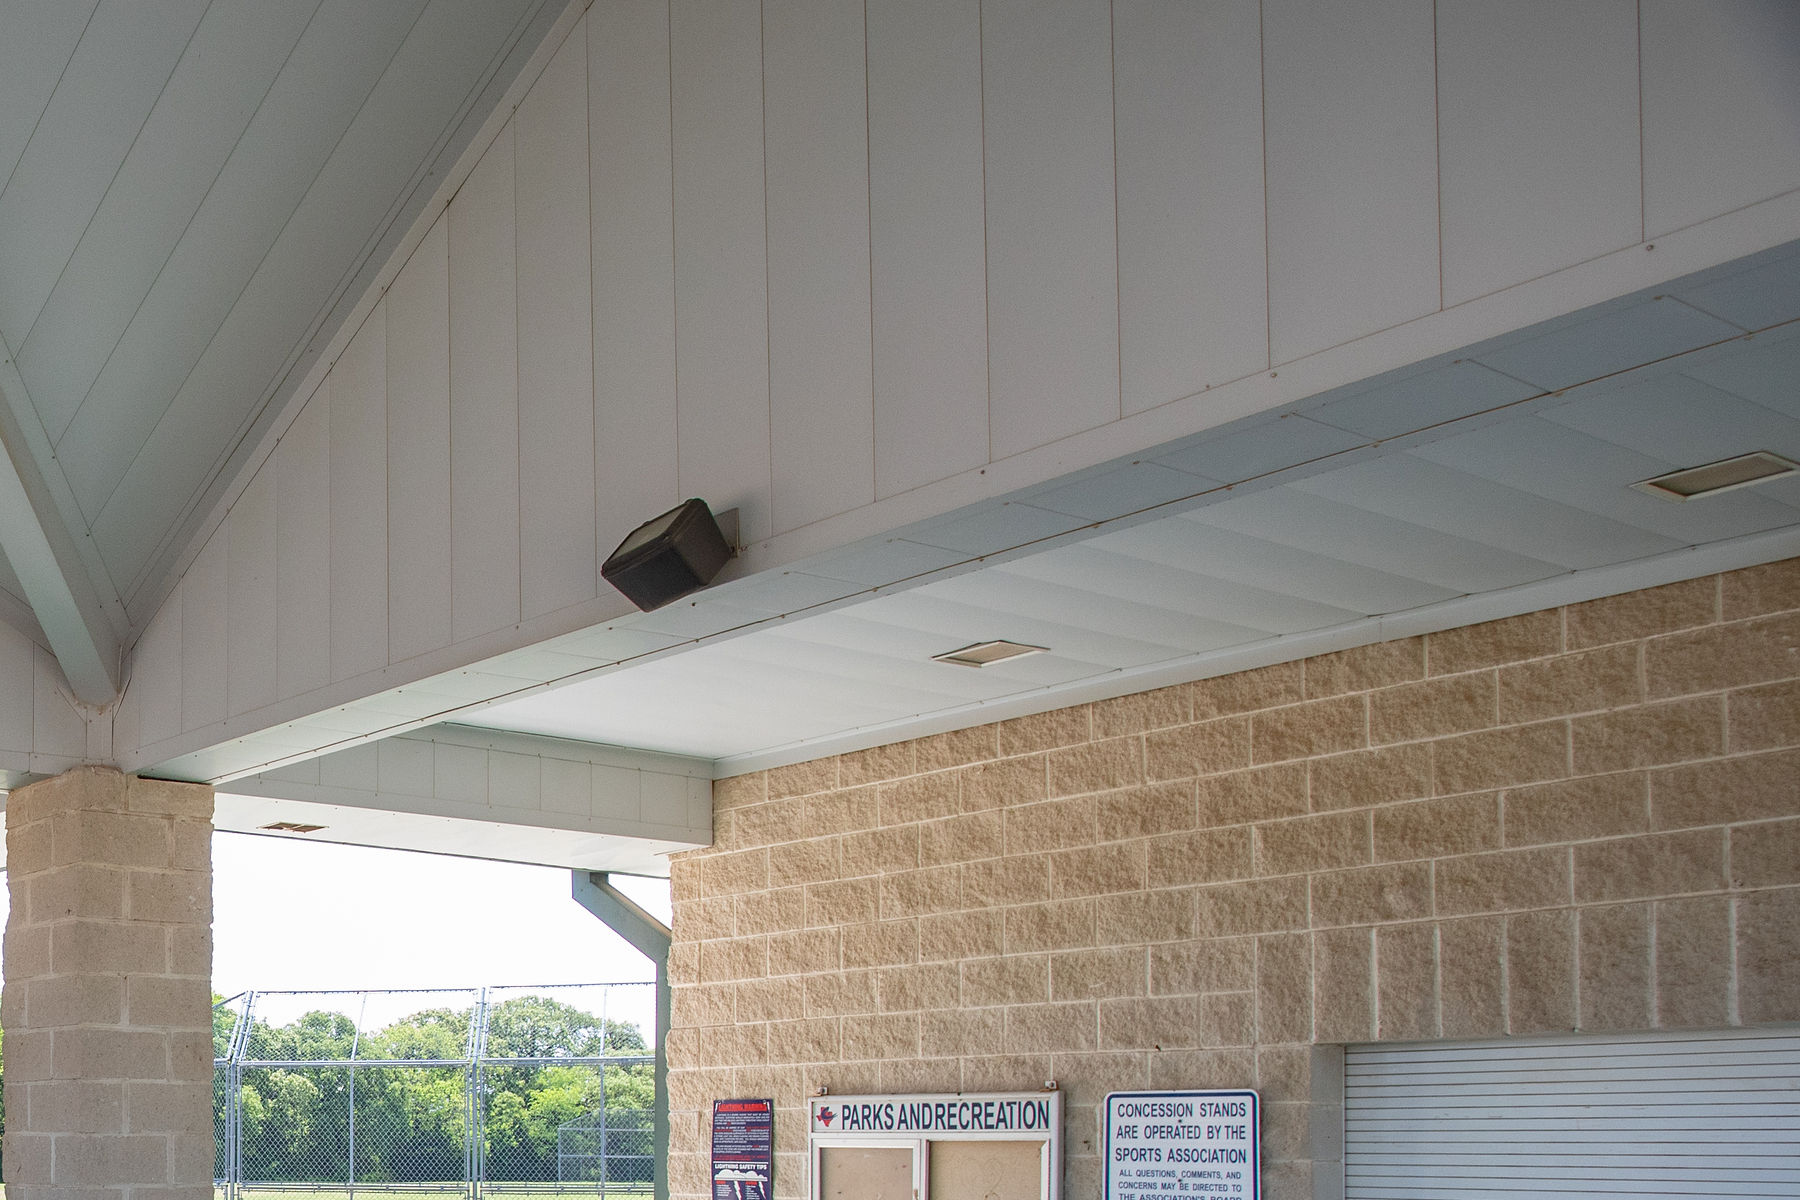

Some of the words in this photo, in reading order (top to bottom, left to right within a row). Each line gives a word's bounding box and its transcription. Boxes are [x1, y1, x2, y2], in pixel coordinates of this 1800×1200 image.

[841, 1103, 894, 1130] PARKS
[1117, 1103, 1193, 1118] CONCESSION
[1199, 1102, 1247, 1117] STANDS
[1116, 1125, 1138, 1139] ARE
[1144, 1125, 1201, 1139] OPERATED
[1207, 1125, 1222, 1139] BY
[1224, 1125, 1246, 1140] THE
[1115, 1147, 1162, 1162] SPORTS
[1167, 1148, 1247, 1164] ASSOCIATION
[1119, 1169, 1132, 1177] ALL
[1136, 1169, 1178, 1179] QUESTIONS,
[1181, 1170, 1223, 1180] COMMENTS,
[1226, 1171, 1241, 1179] AND
[1118, 1181, 1157, 1190] CONCERNS
[1161, 1182, 1176, 1190] MAY
[1179, 1182, 1189, 1191] BE
[1192, 1183, 1228, 1192] DIRECTED
[1232, 1184, 1242, 1192] TO
[1119, 1193, 1136, 1200] THE
